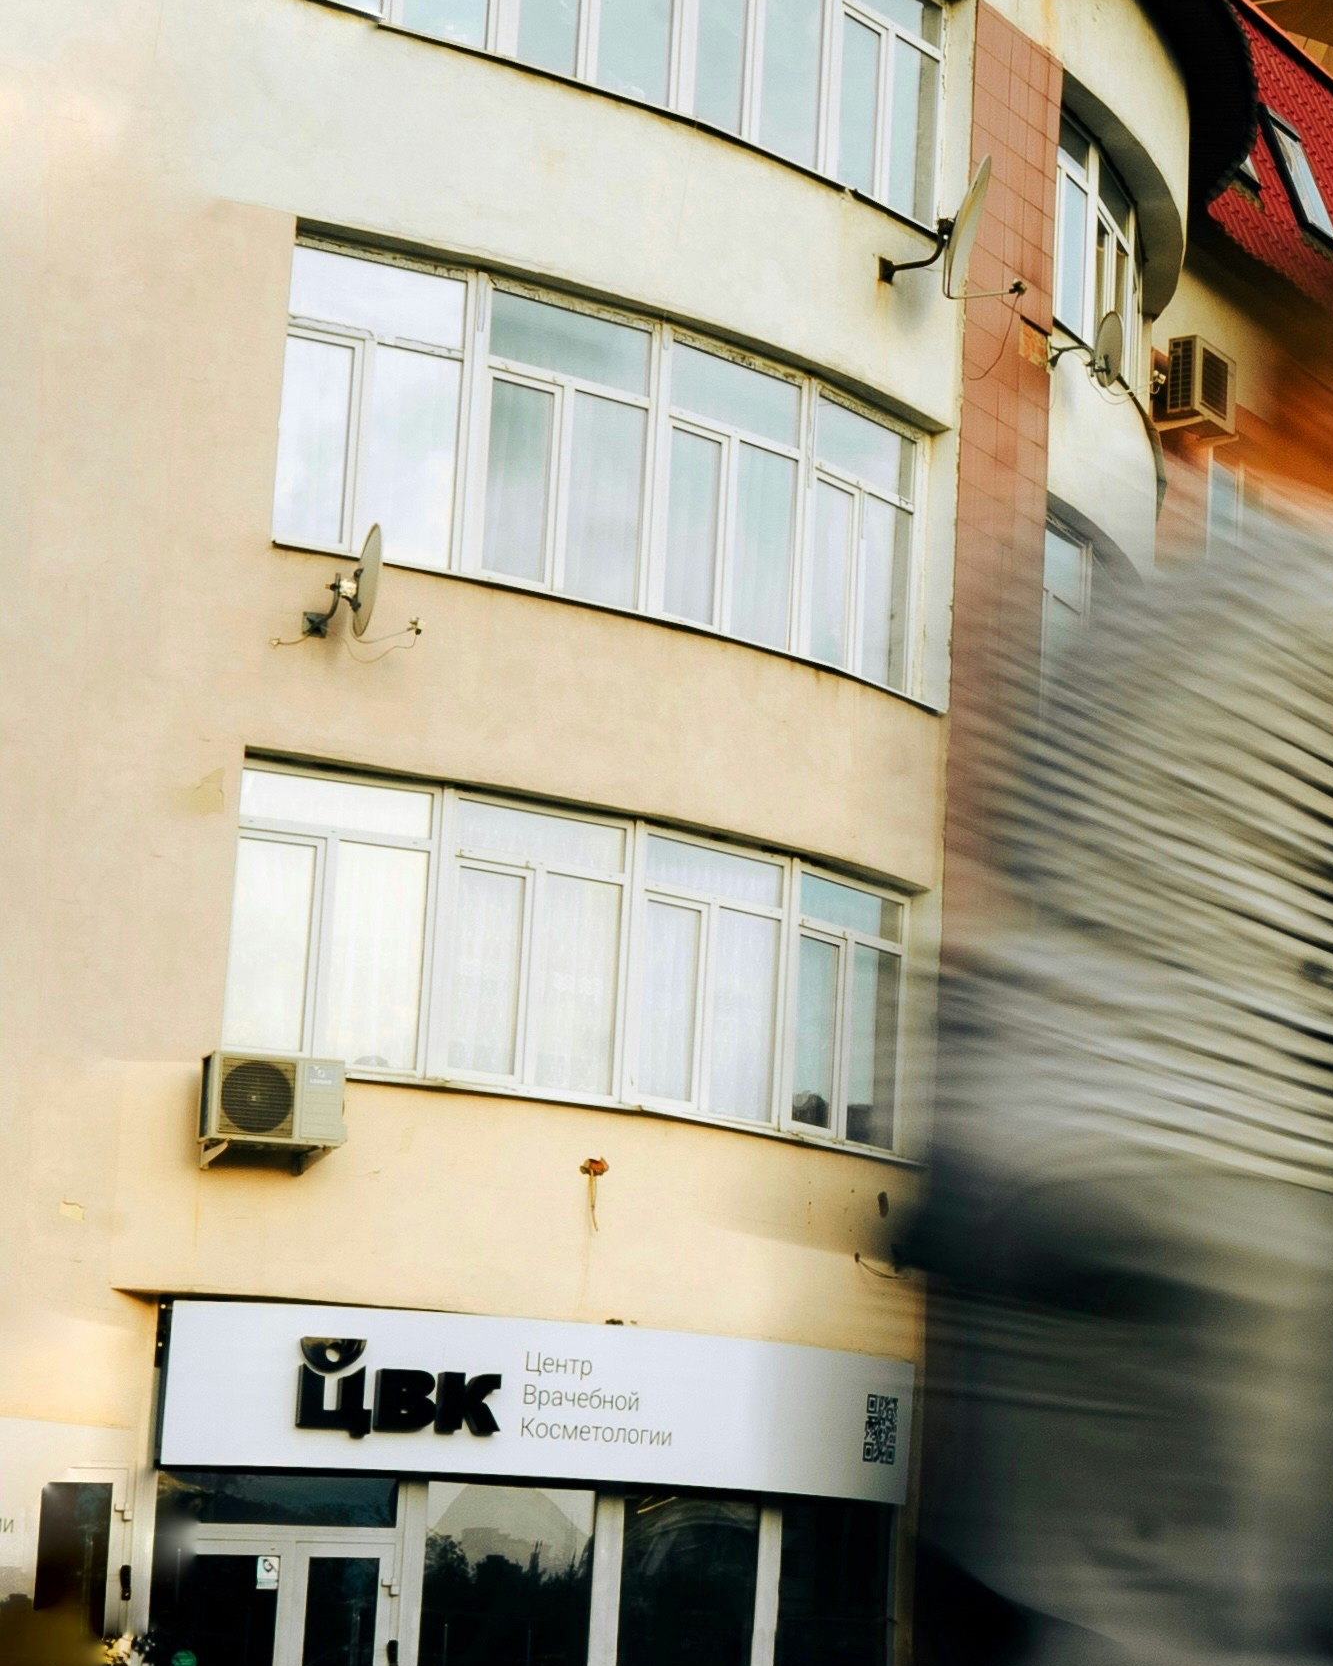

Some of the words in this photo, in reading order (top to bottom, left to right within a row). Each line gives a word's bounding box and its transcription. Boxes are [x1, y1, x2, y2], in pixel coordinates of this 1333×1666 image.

[525, 1351, 593, 1380] Центр
[523, 1384, 640, 1411] Врачебной
[521, 1417, 673, 1446] Косметологии
